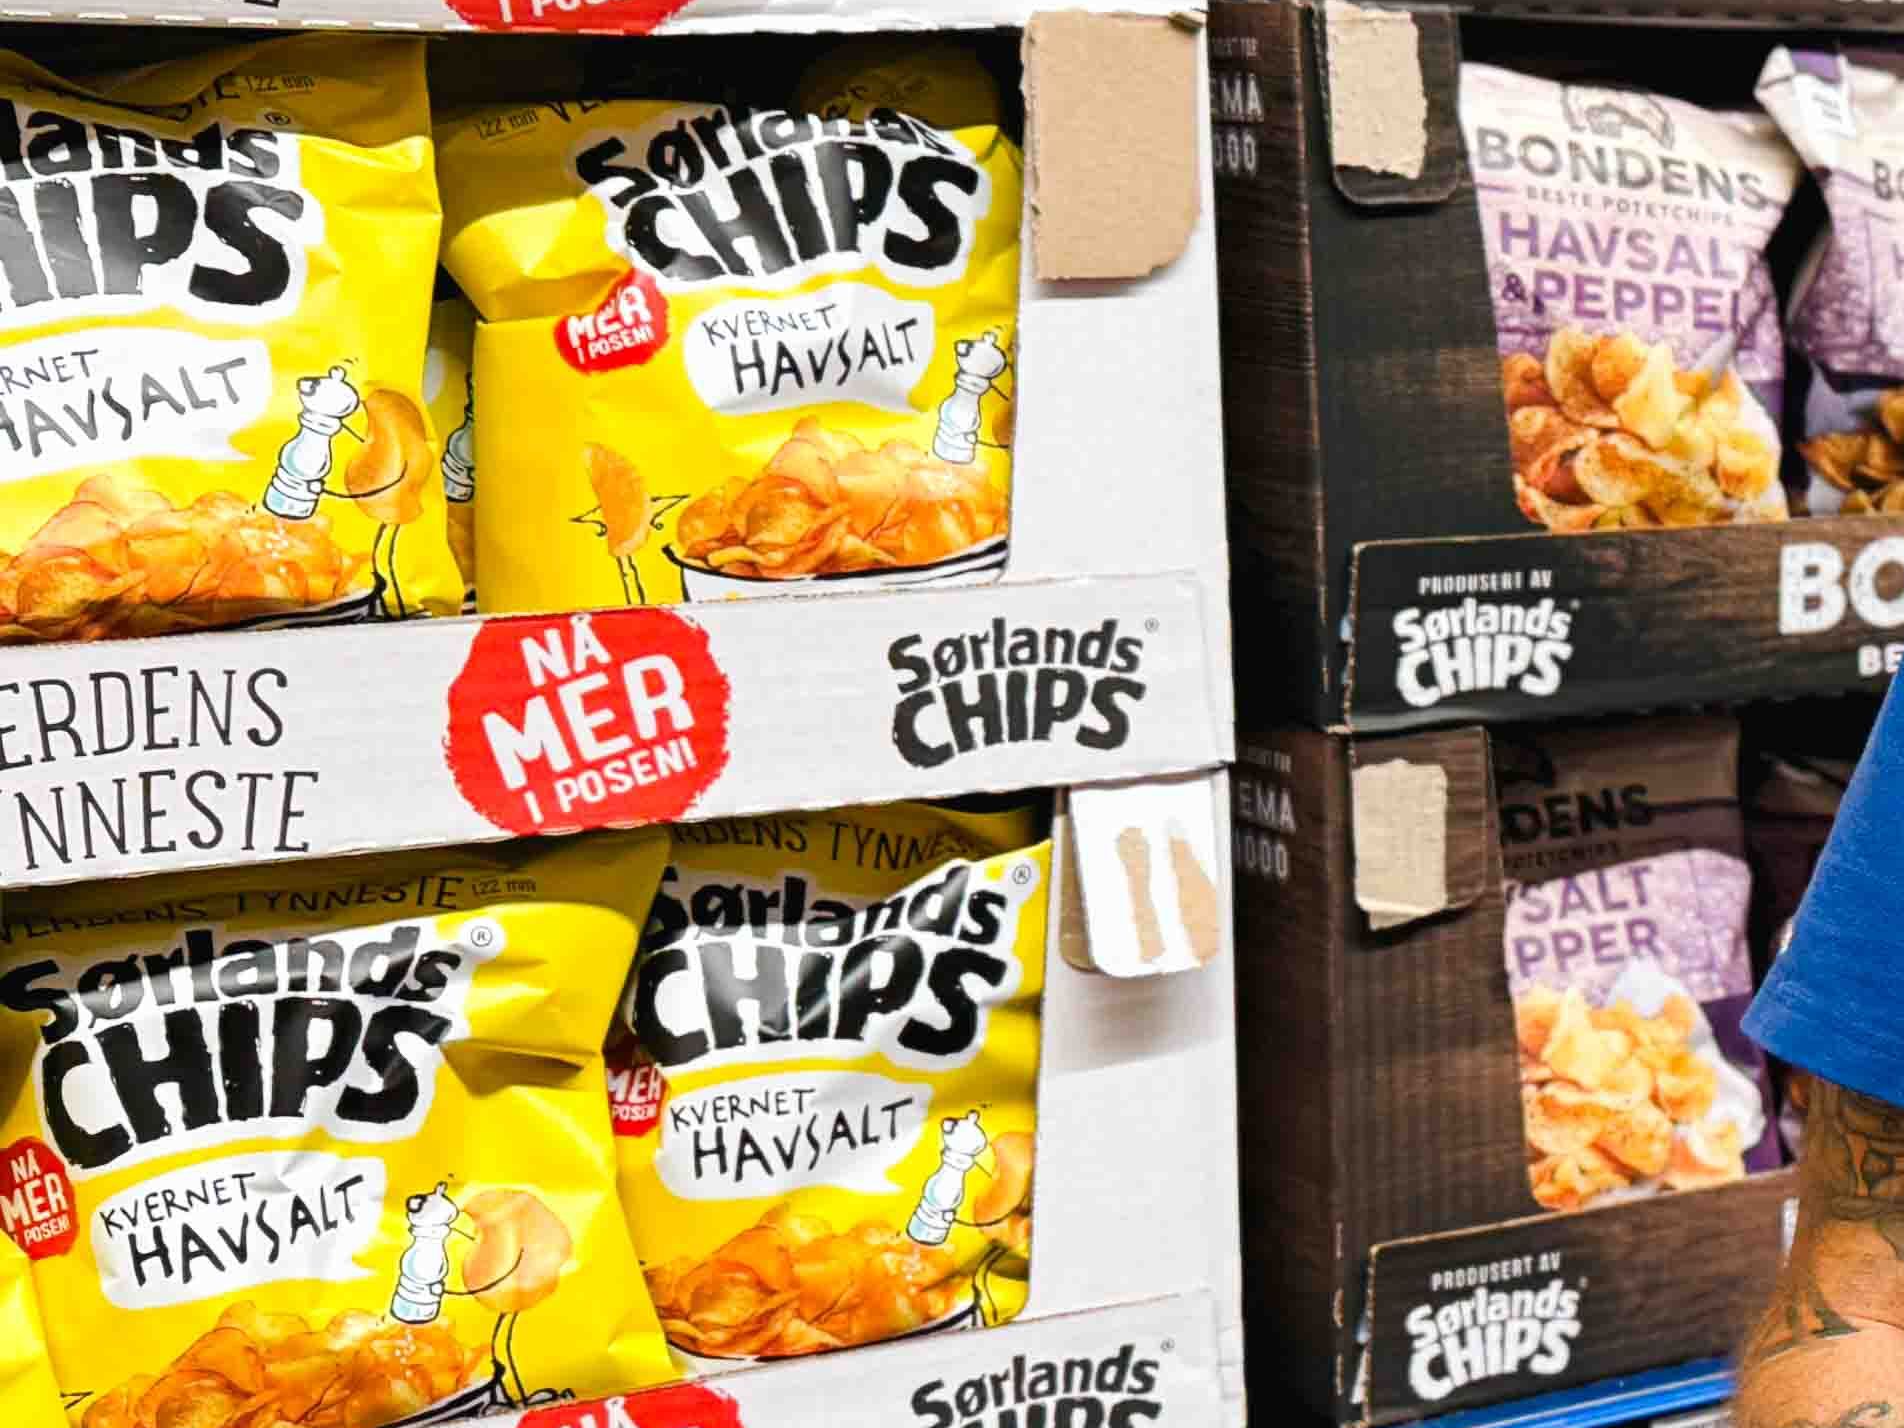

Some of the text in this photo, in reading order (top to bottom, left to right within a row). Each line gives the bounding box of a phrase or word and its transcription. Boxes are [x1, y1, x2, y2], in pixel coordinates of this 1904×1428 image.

[1476, 126, 1770, 211] BONDENS
[1526, 185, 1595, 210] BESTE
[622, 140, 981, 282] CHIPS
[702, 303, 838, 346] KVERNET
[729, 318, 920, 397] HAVSALT
[1418, 569, 1554, 597] PRODUSERT AV
[519, 615, 611, 689] NÅ
[887, 616, 1145, 695] Sørlands
[1392, 596, 1574, 654] Sørlands
[1395, 633, 1574, 709] CHIPS
[479, 653, 697, 792] MER
[891, 667, 1148, 770] CHIPS
[524, 791, 545, 825] I
[235, 875, 465, 918] TYNNESTE
[1505, 864, 1653, 923] SALT
[0, 925, 464, 1045] Sørlands
[635, 934, 1010, 1067] CHIPS
[41, 995, 454, 1171] CHIPS
[670, 1088, 817, 1133] KVERNET
[692, 1098, 914, 1183] HAVSALT
[0, 1172, 69, 1235] MER
[99, 1171, 256, 1239] KVERNET
[127, 1174, 365, 1288] HAVSALT
[1430, 1251, 1563, 1292] PRODUSERT AV
[1404, 1278, 1583, 1352] Sørlands
[1408, 1317, 1583, 1402] CHIPS
